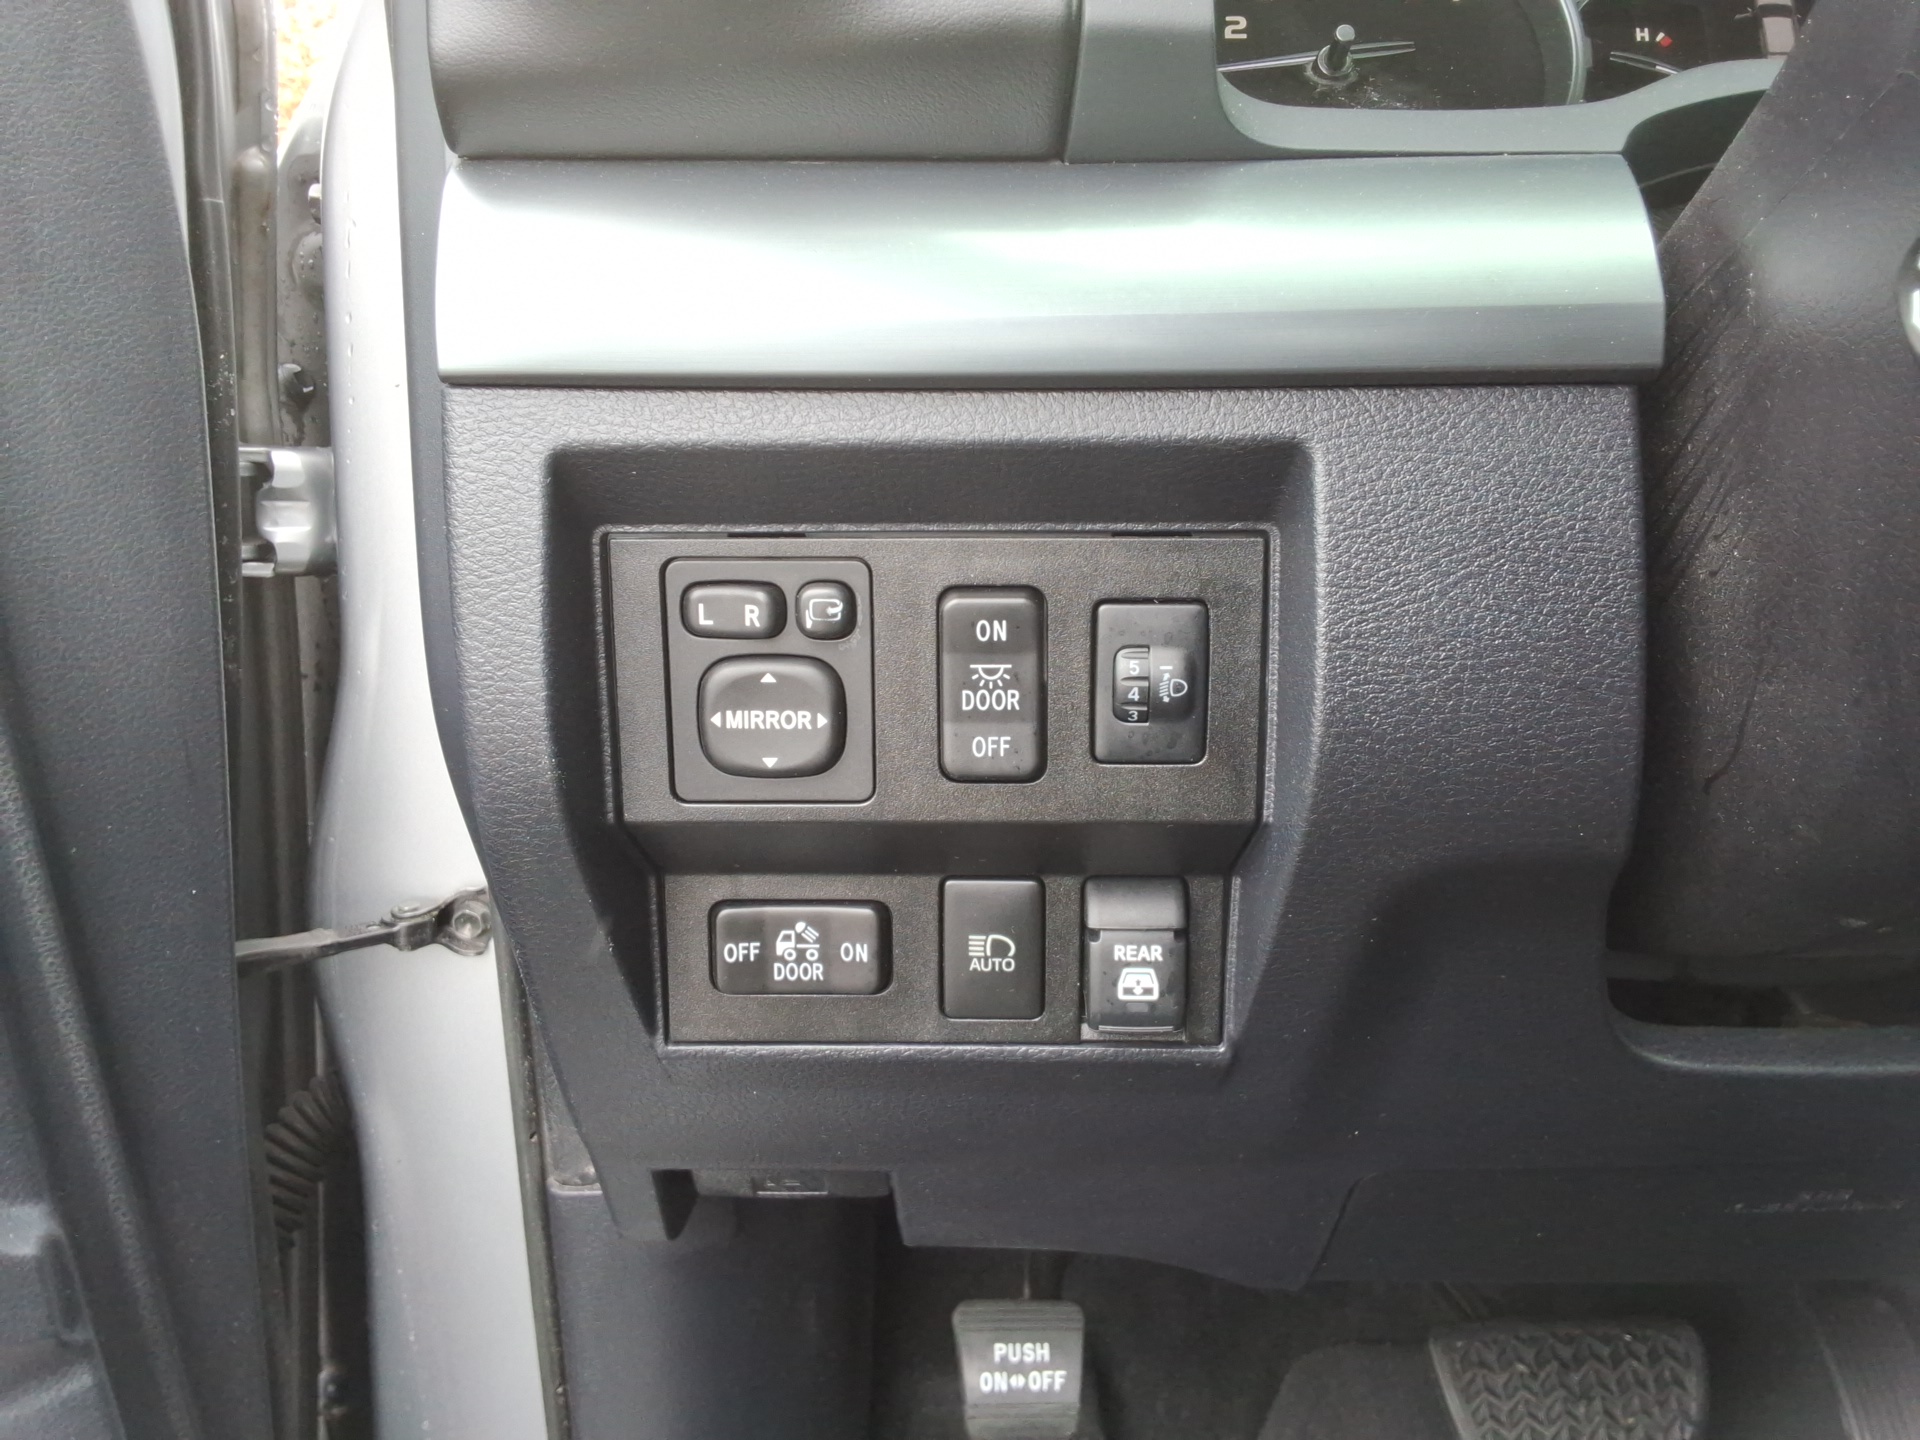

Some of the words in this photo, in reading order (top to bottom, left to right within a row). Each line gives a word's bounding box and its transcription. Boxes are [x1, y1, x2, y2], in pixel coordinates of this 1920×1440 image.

[1224, 16, 1247, 39] 2
[1635, 27, 1650, 42] H
[698, 603, 714, 625] L
[744, 604, 760, 627] R
[975, 619, 1008, 642] ON
[1128, 660, 1140, 675] 5
[961, 690, 1020, 711] DOOR
[1127, 687, 1140, 702] 4
[725, 710, 812, 729] MIRROR
[1127, 710, 1138, 722] 3
[972, 736, 1011, 757] OFF
[723, 942, 760, 963] OFF
[840, 943, 868, 963] ON
[1113, 943, 1163, 962] REAR
[773, 963, 824, 983] DOOR
[969, 956, 1015, 973] AUTO
[993, 1342, 1050, 1364] PUSH
[979, 1371, 1008, 1394] ON
[1027, 1370, 1067, 1393] OFF
